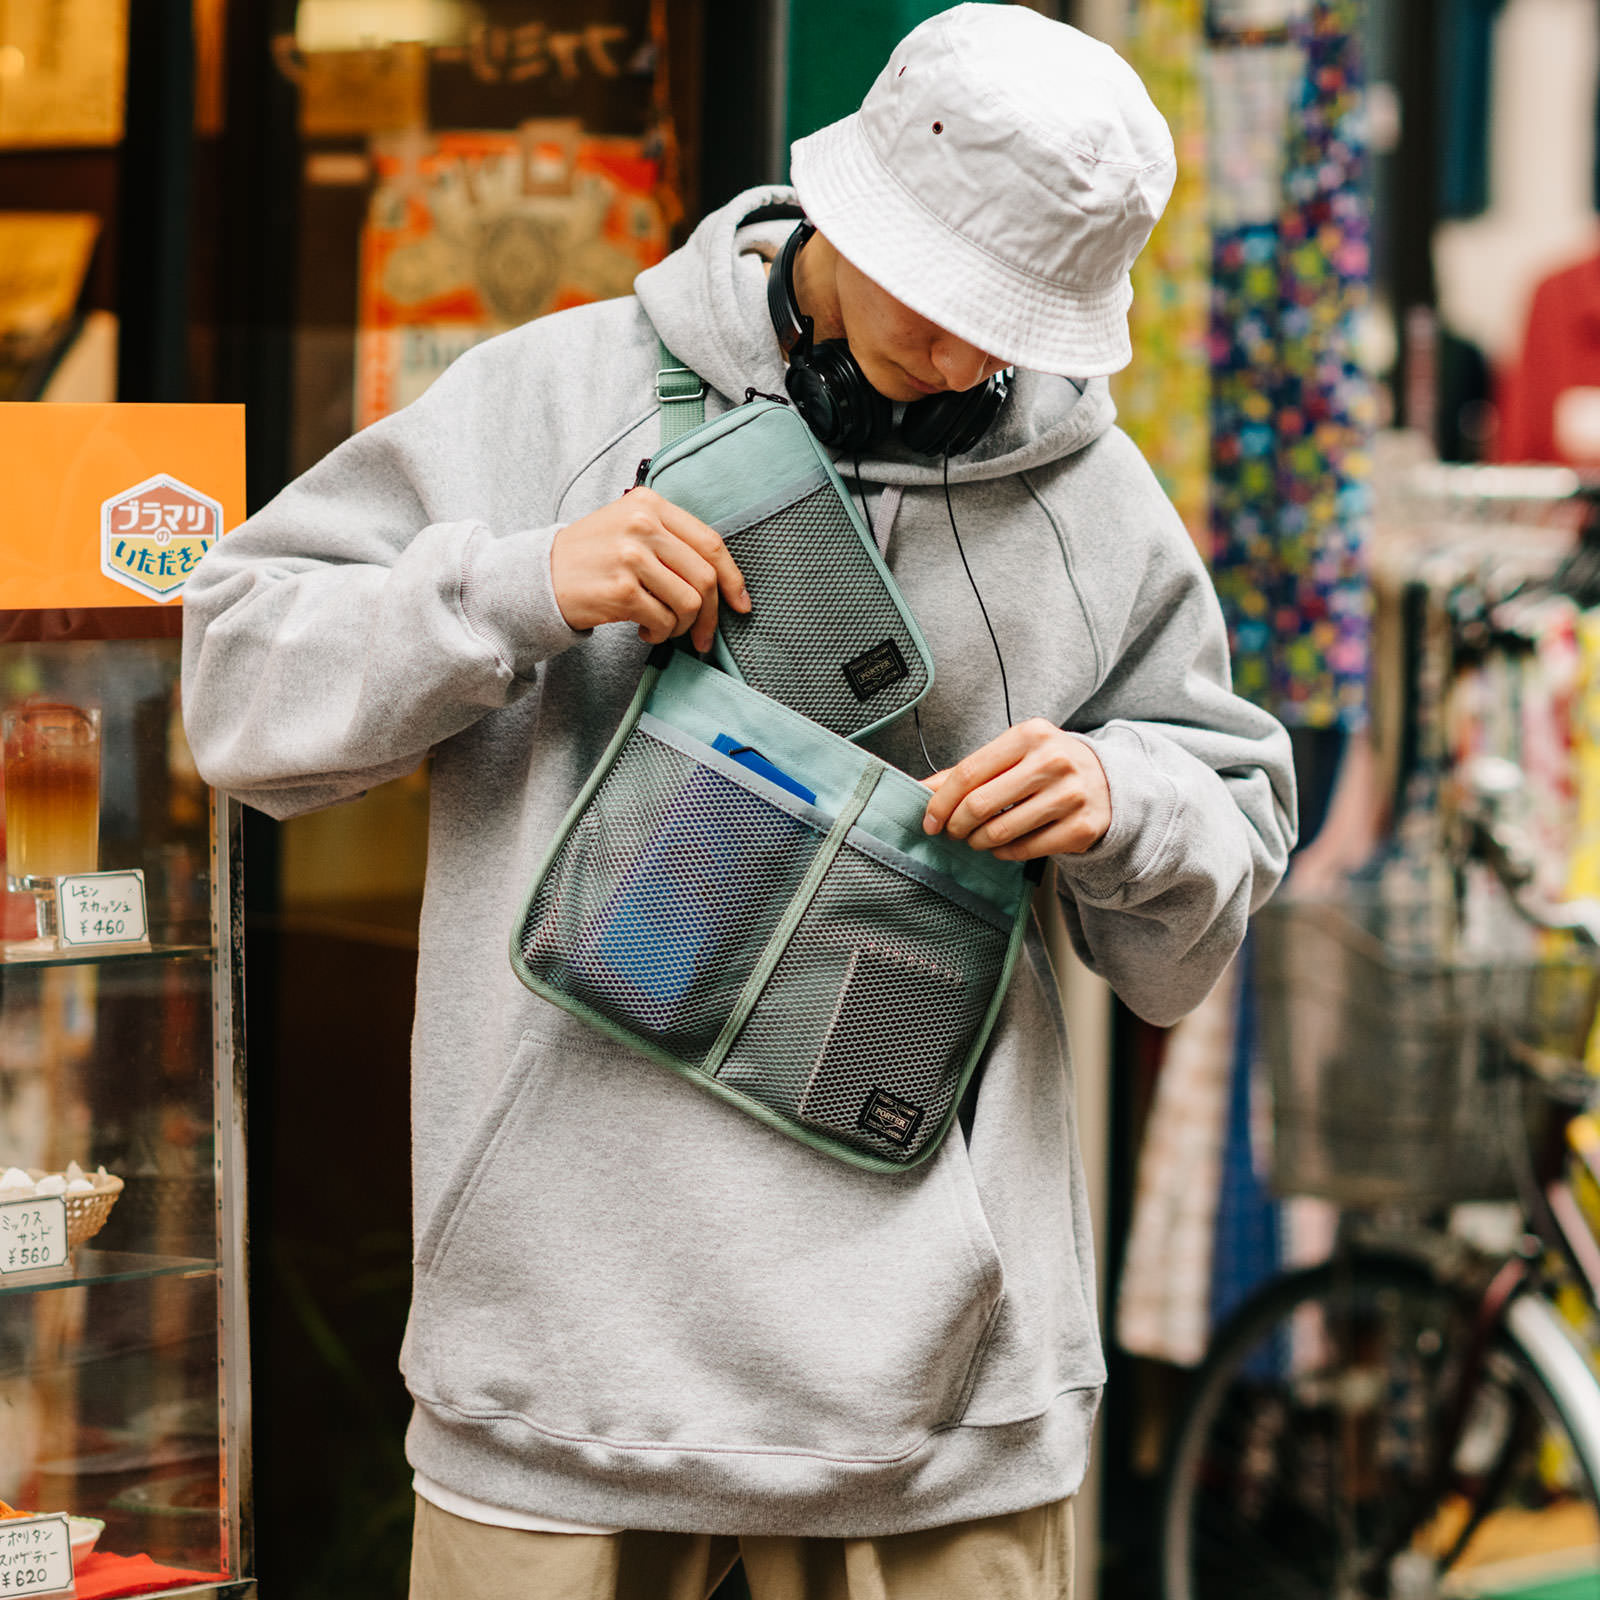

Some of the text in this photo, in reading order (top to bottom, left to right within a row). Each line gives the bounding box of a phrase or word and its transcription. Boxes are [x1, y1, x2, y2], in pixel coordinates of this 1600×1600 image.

[118, 500, 206, 532] ブラマリ
[156, 531, 170, 543] の
[115, 539, 209, 576] いただき
[860, 659, 891, 680] PORTER
[71, 884, 99, 898] レモン
[79, 900, 133, 913] スカッシュ
[875, 1107, 906, 1128] PORTER
[1, 1568, 47, 1588] ¥620
